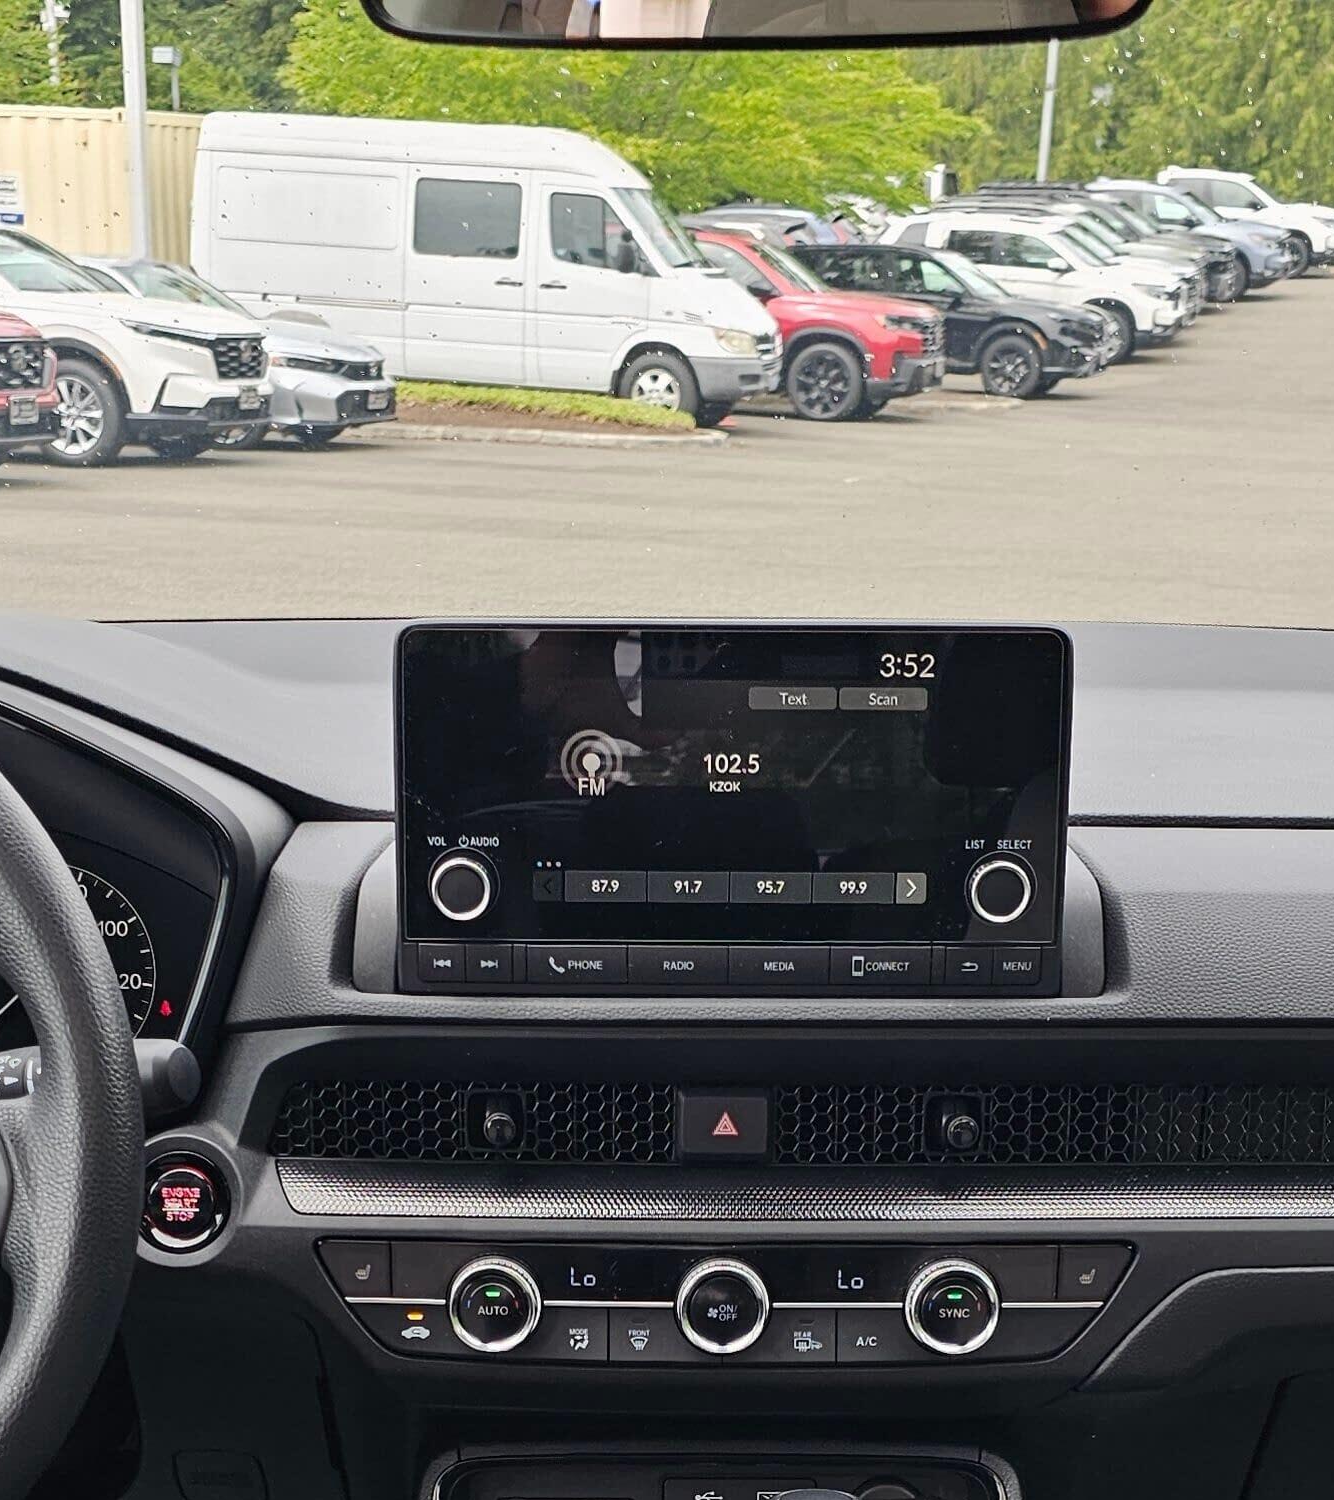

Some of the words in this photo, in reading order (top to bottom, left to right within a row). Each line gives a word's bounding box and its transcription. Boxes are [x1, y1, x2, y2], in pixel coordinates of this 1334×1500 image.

[879, 653, 937, 679] 3:52
[779, 692, 809, 706] Text
[867, 692, 899, 707] Scan
[703, 753, 761, 775] 102.5
[577, 777, 606, 797] FM
[709, 781, 741, 793] KZOK
[427, 836, 447, 847] VOL
[470, 836, 500, 848] AUDIO
[965, 839, 985, 850] LIST
[996, 839, 1032, 850] SELECT
[591, 879, 620, 893] 87.9
[673, 880, 703, 894] 91.7
[756, 880, 786, 894] 95.7
[839, 880, 868, 895] 99.9
[567, 960, 603, 970] PHONE
[663, 961, 695, 971] RADIO
[763, 961, 795, 971] MEDIA
[865, 962, 910, 972] CONNECT
[1002, 961, 1032, 971] MENU
[119, 973, 142, 990] 20
[161, 1187, 200, 1198] ENGINE
[164, 1198, 198, 1208] START
[166, 1211, 194, 1222] STOP
[570, 1266, 596, 1287] Lo
[837, 1269, 864, 1289] Lo
[477, 1305, 509, 1316] AUTO
[718, 1304, 738, 1314] ON/
[938, 1308, 970, 1319] SYNC
[718, 1312, 738, 1321] OFF
[628, 1329, 650, 1337] FRONT
[855, 1336, 878, 1347] A/C
